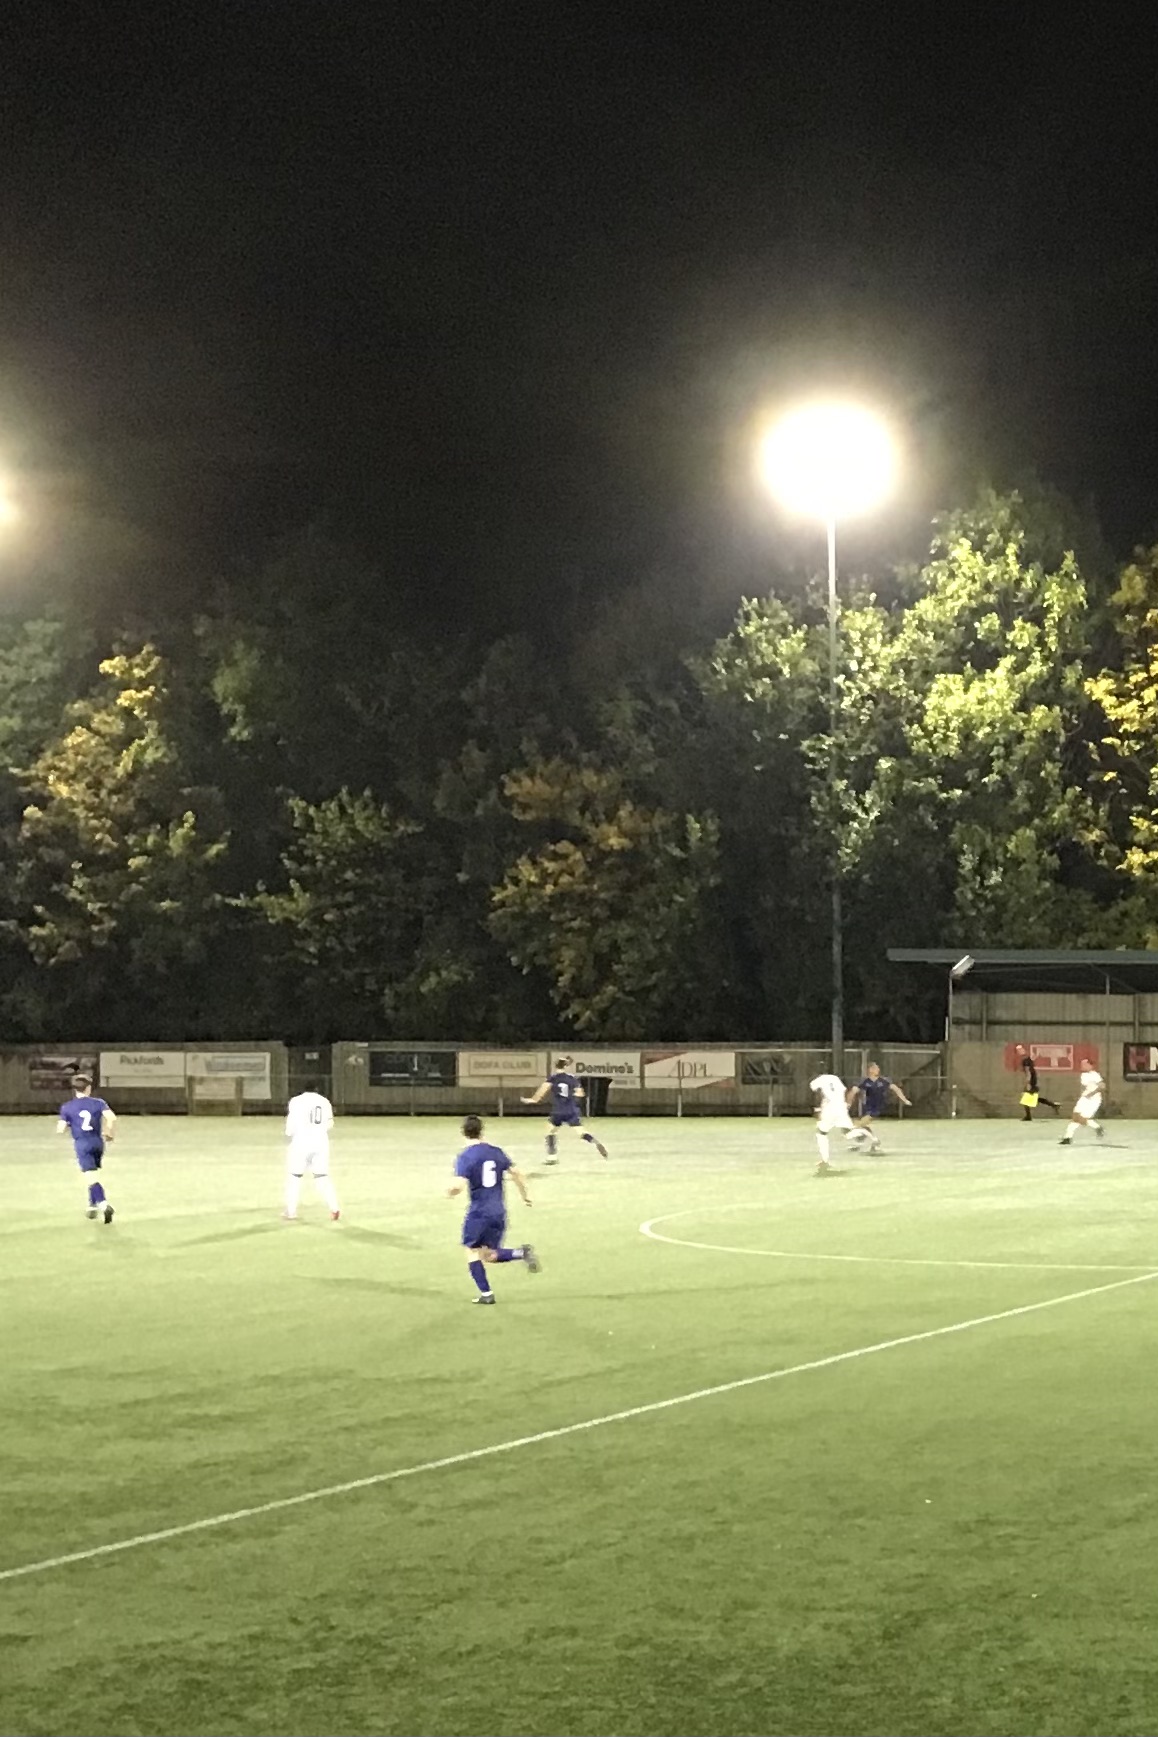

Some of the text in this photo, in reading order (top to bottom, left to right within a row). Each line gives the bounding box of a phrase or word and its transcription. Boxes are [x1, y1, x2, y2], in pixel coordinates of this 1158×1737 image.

[575, 1061, 634, 1074] Domino's
[78, 1109, 94, 1131] 2
[481, 1159, 498, 1188] 6
